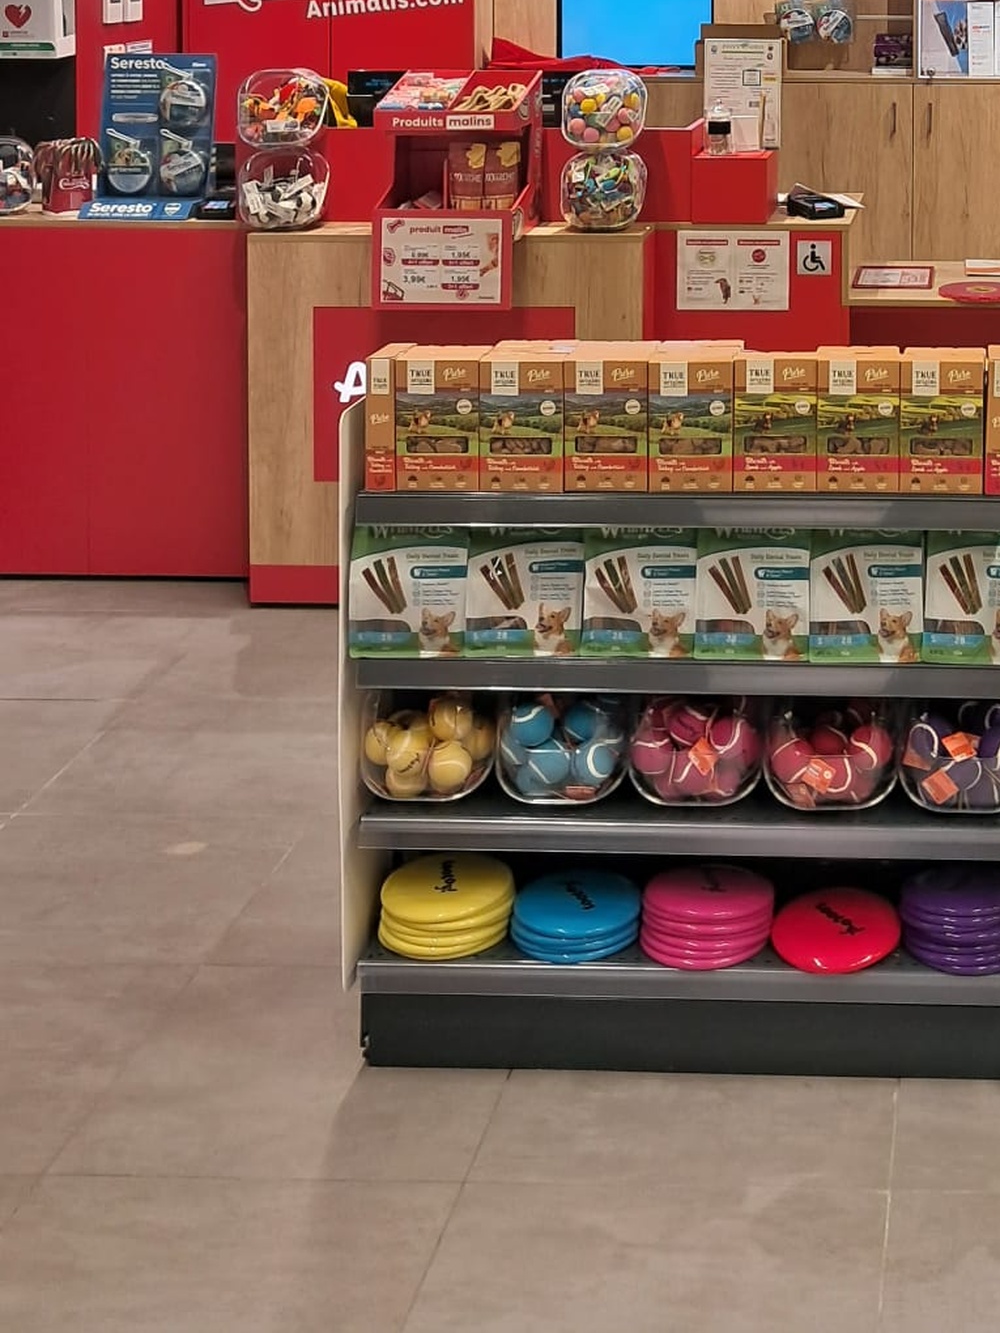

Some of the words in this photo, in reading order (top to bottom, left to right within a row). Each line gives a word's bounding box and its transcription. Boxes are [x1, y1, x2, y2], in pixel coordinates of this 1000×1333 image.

[111, 57, 166, 70] Seresto
[392, 117, 444, 128] Produits
[448, 116, 493, 127] malins
[90, 203, 154, 213] Seresto
